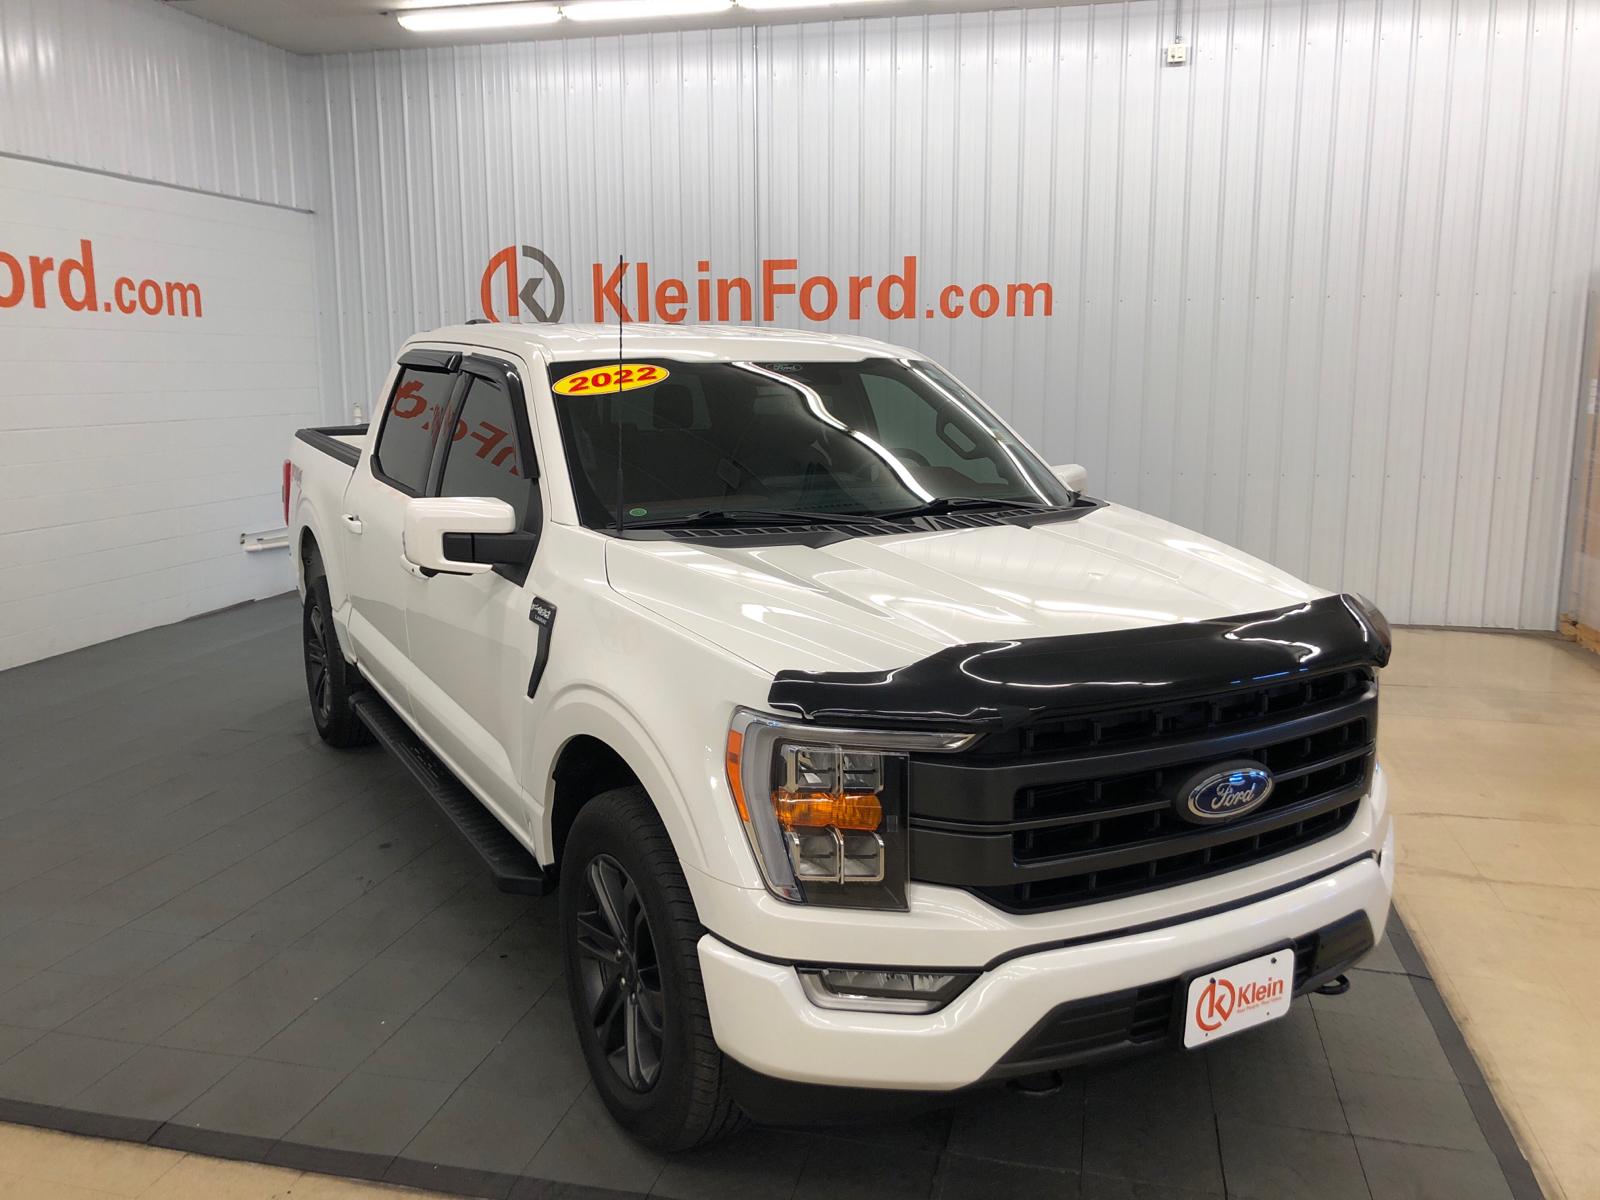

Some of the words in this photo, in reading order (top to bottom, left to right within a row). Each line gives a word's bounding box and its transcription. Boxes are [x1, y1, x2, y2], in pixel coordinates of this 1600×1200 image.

[592, 256, 1052, 323] KleinFord.com
[568, 366, 658, 393] 2022
[773, 363, 796, 371] Ford
[1211, 782, 1256, 809] Ford
[1237, 977, 1284, 1008] Klein
